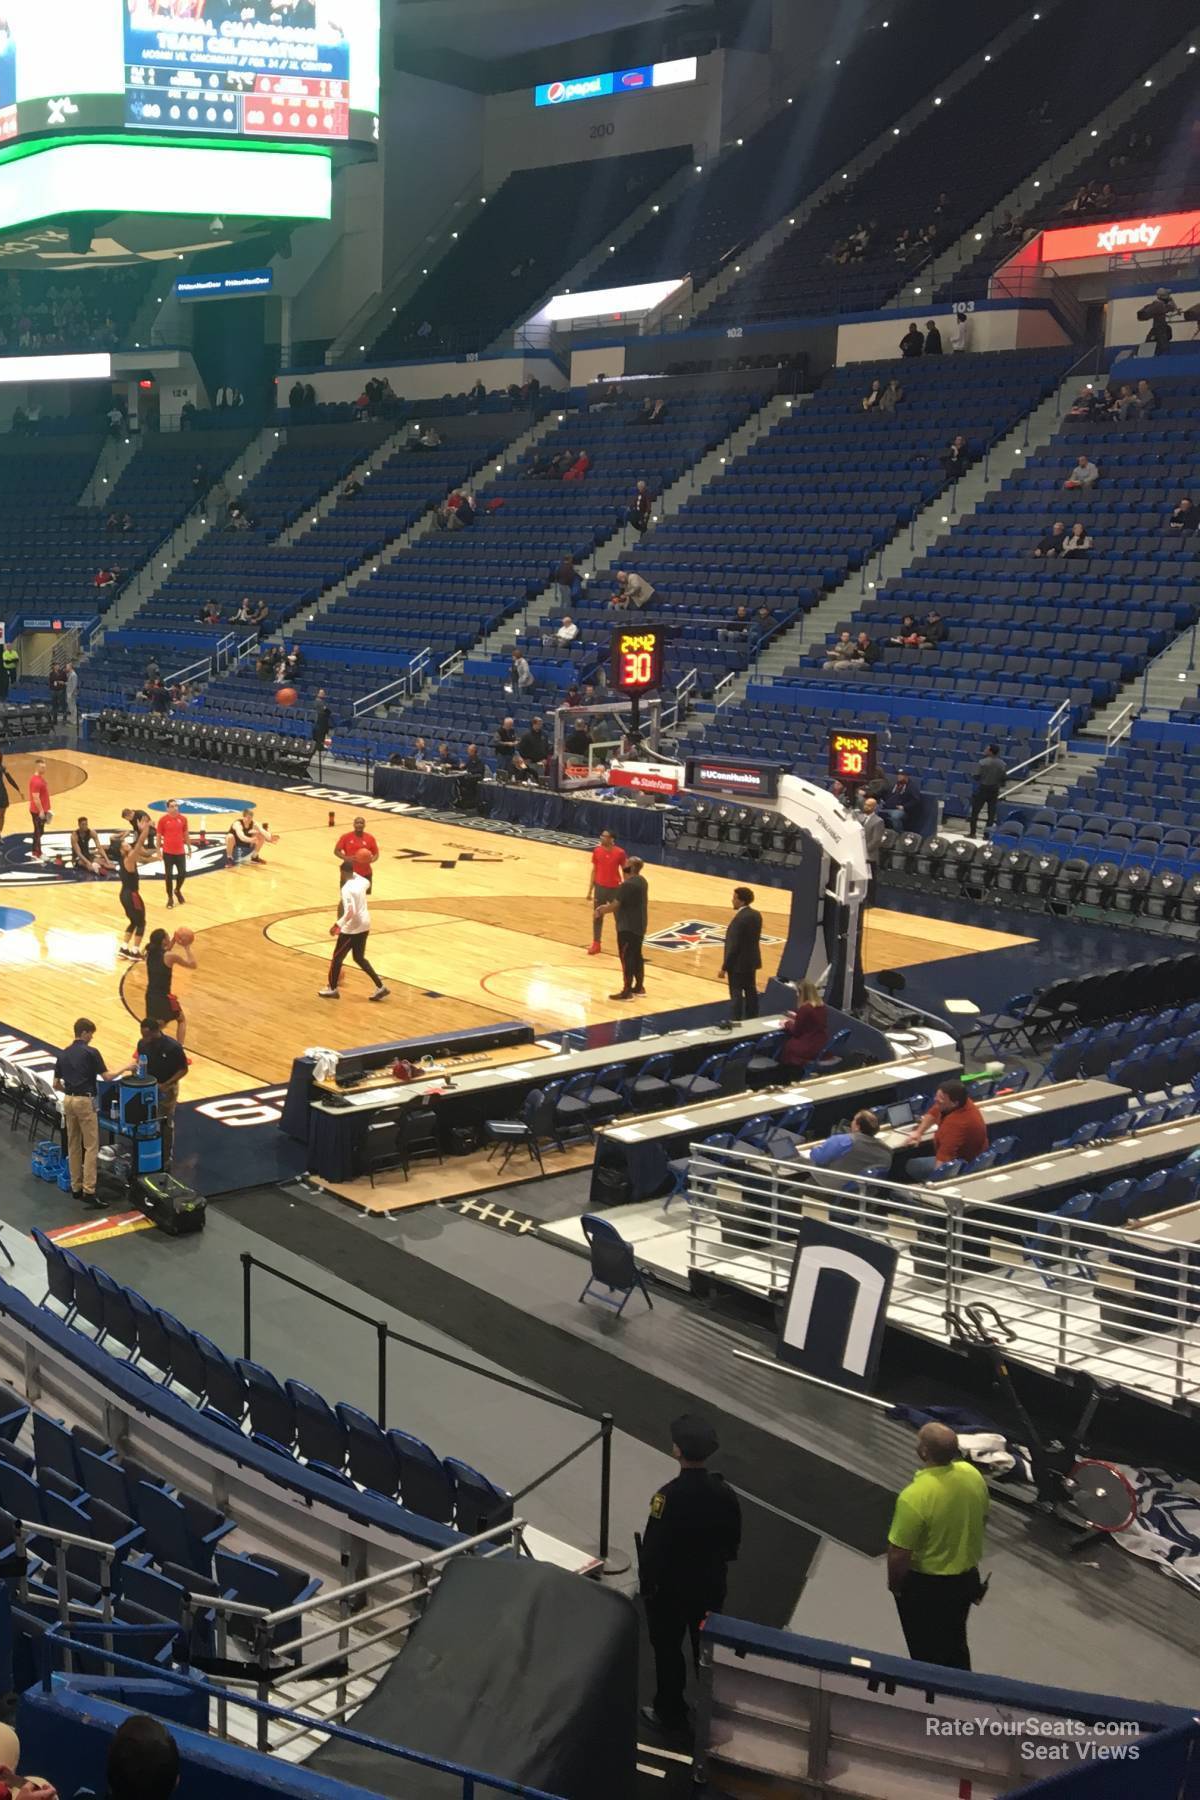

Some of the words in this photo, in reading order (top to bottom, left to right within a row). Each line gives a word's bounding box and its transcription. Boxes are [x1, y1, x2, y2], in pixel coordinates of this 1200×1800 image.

[565, 78, 601, 99] pepsi
[1097, 223, 1161, 250] xfinity
[951, 301, 975, 314] 103
[727, 327, 743, 338] 102
[171, 388, 188, 397] 124
[621, 633, 655, 653] 24:42
[624, 653, 651, 684] 30
[835, 736, 869, 753] 24:42
[842, 753, 861, 773] 30
[283, 784, 425, 813] UCONN
